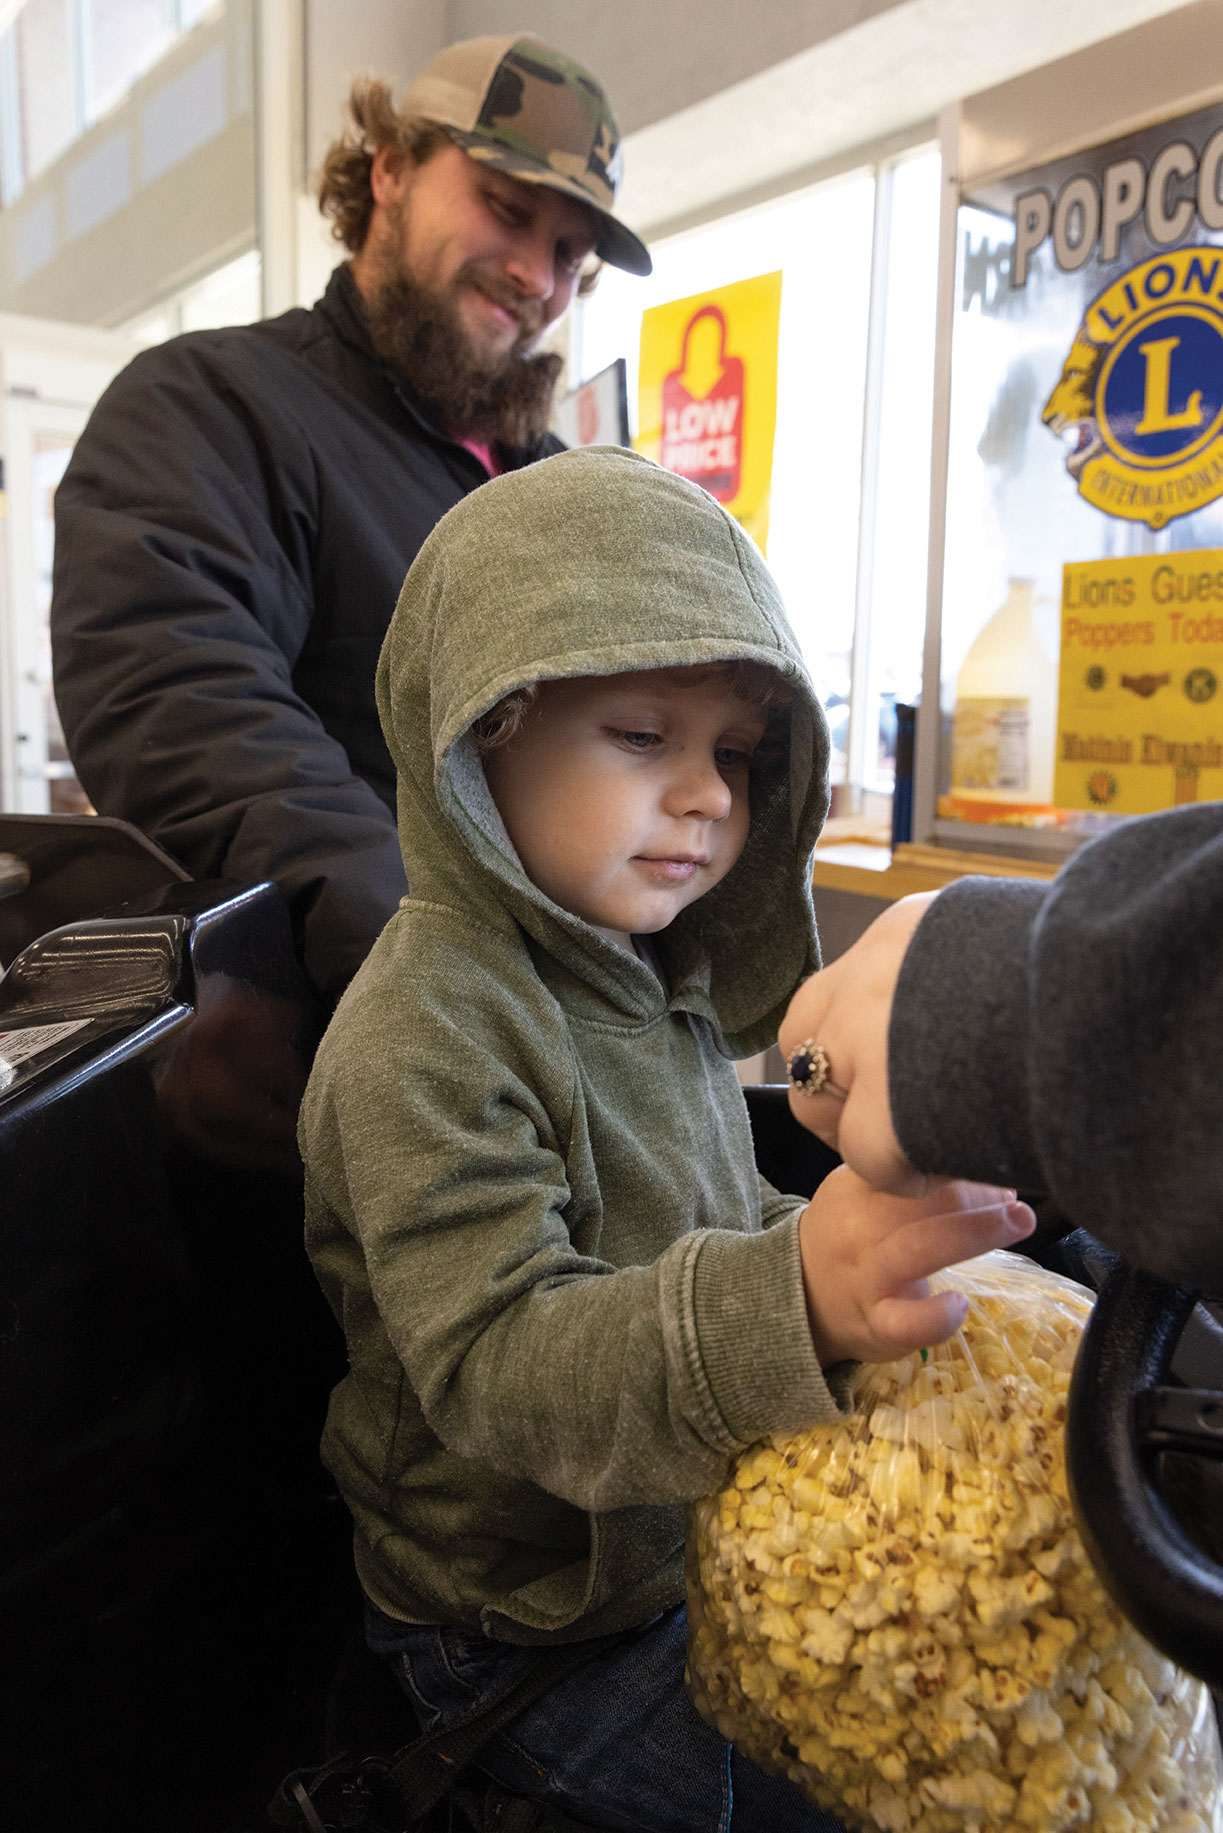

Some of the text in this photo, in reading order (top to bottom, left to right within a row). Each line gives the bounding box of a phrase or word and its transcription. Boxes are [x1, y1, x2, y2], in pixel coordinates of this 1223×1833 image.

[1099, 256, 1223, 331] LION
[1135, 336, 1203, 436] L
[664, 395, 739, 442] LOW
[1064, 572, 1136, 609] Lions
[1064, 616, 1155, 653] Poppers
